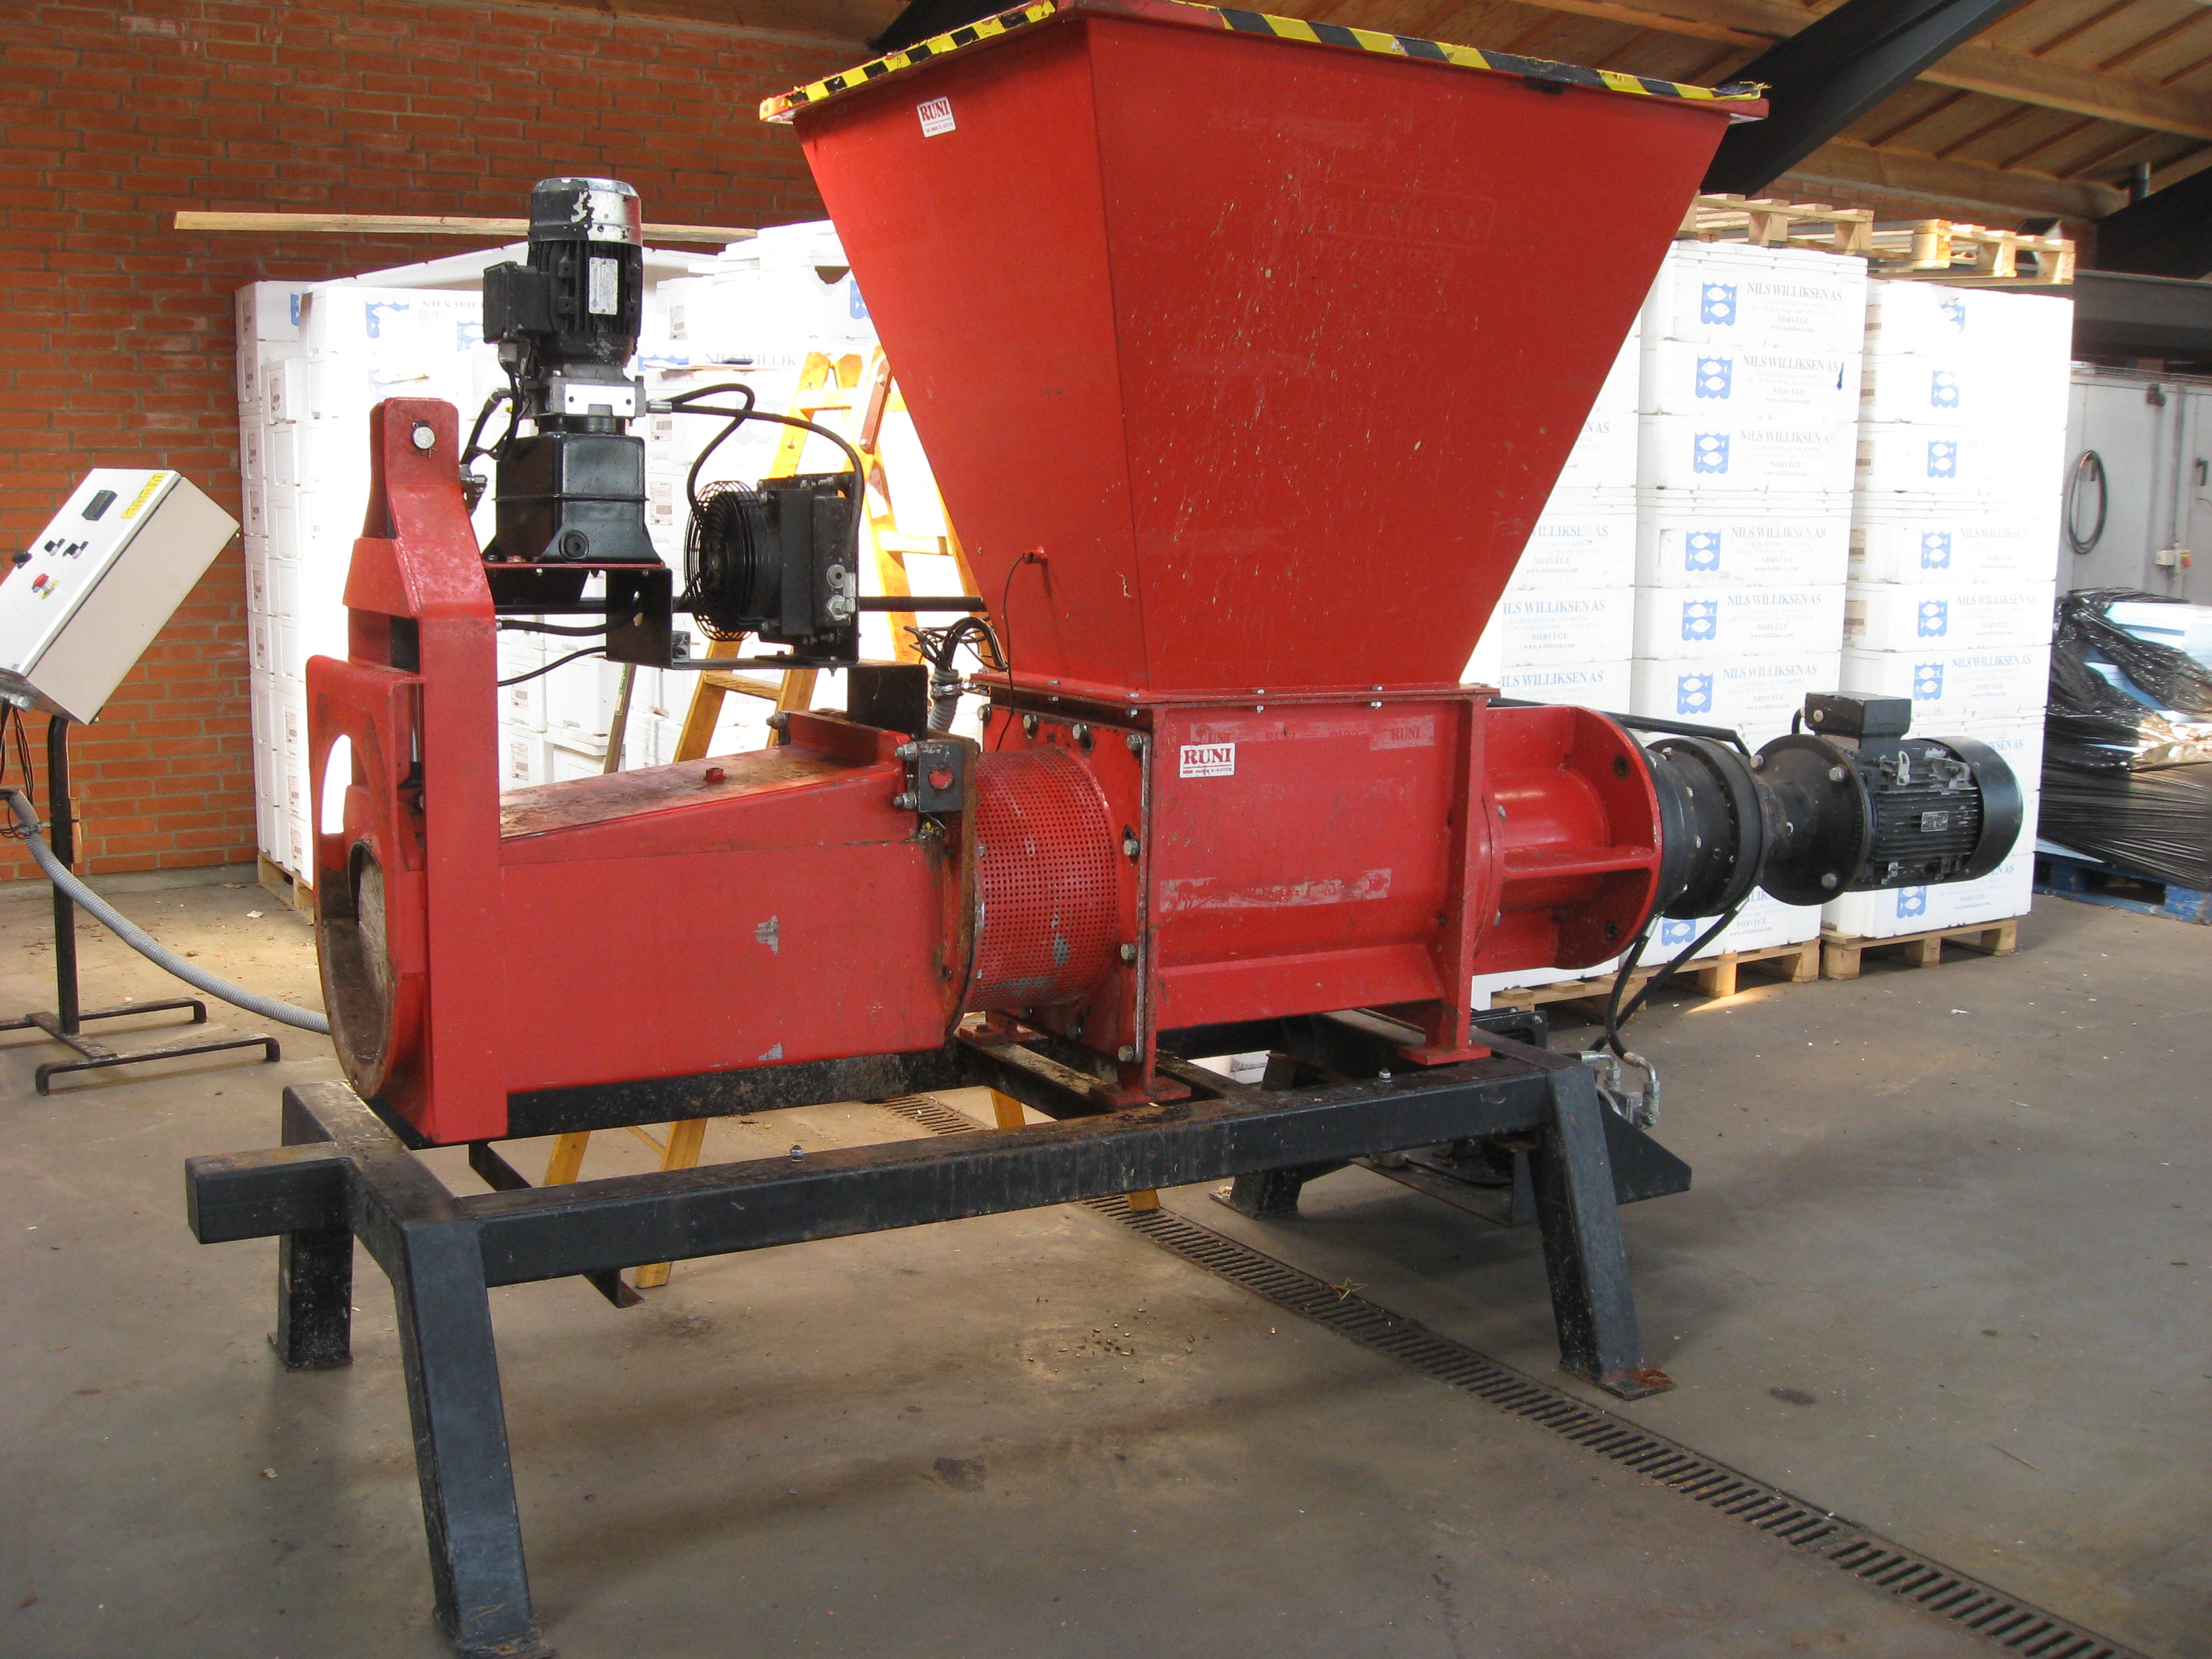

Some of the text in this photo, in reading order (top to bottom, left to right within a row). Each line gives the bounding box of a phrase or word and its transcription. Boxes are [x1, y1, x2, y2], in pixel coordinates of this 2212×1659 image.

[919, 100, 950, 121] RUNI
[1747, 282, 1843, 301] NILS WILLIKSEN AS
[1742, 354, 1839, 372] NILS WILLIKSEN AS
[1595, 422, 1610, 434] AS
[1740, 430, 1764, 442] NILS
[1765, 430, 1822, 444] WILLIKSEN
[1731, 527, 1827, 538] NILS WILLIKSEN AS
[1960, 527, 1980, 538] NILS
[1502, 599, 1606, 614] ILS WILLIKSEN AS
[1727, 593, 1822, 607] NILS WILLIKSEN AS
[1957, 595, 1976, 606] NILS
[1978, 594, 2024, 605] WILLIKSEN
[1952, 657, 1972, 668] NILS
[1973, 655, 2020, 667] WILLIKSEN
[1722, 663, 1818, 679] NILS WILLIKSEN AS
[1501, 670, 1604, 687] ILS WILLIKSEN AS
[2013, 739, 2024, 749] AS
[1183, 747, 1232, 764] RUNI
